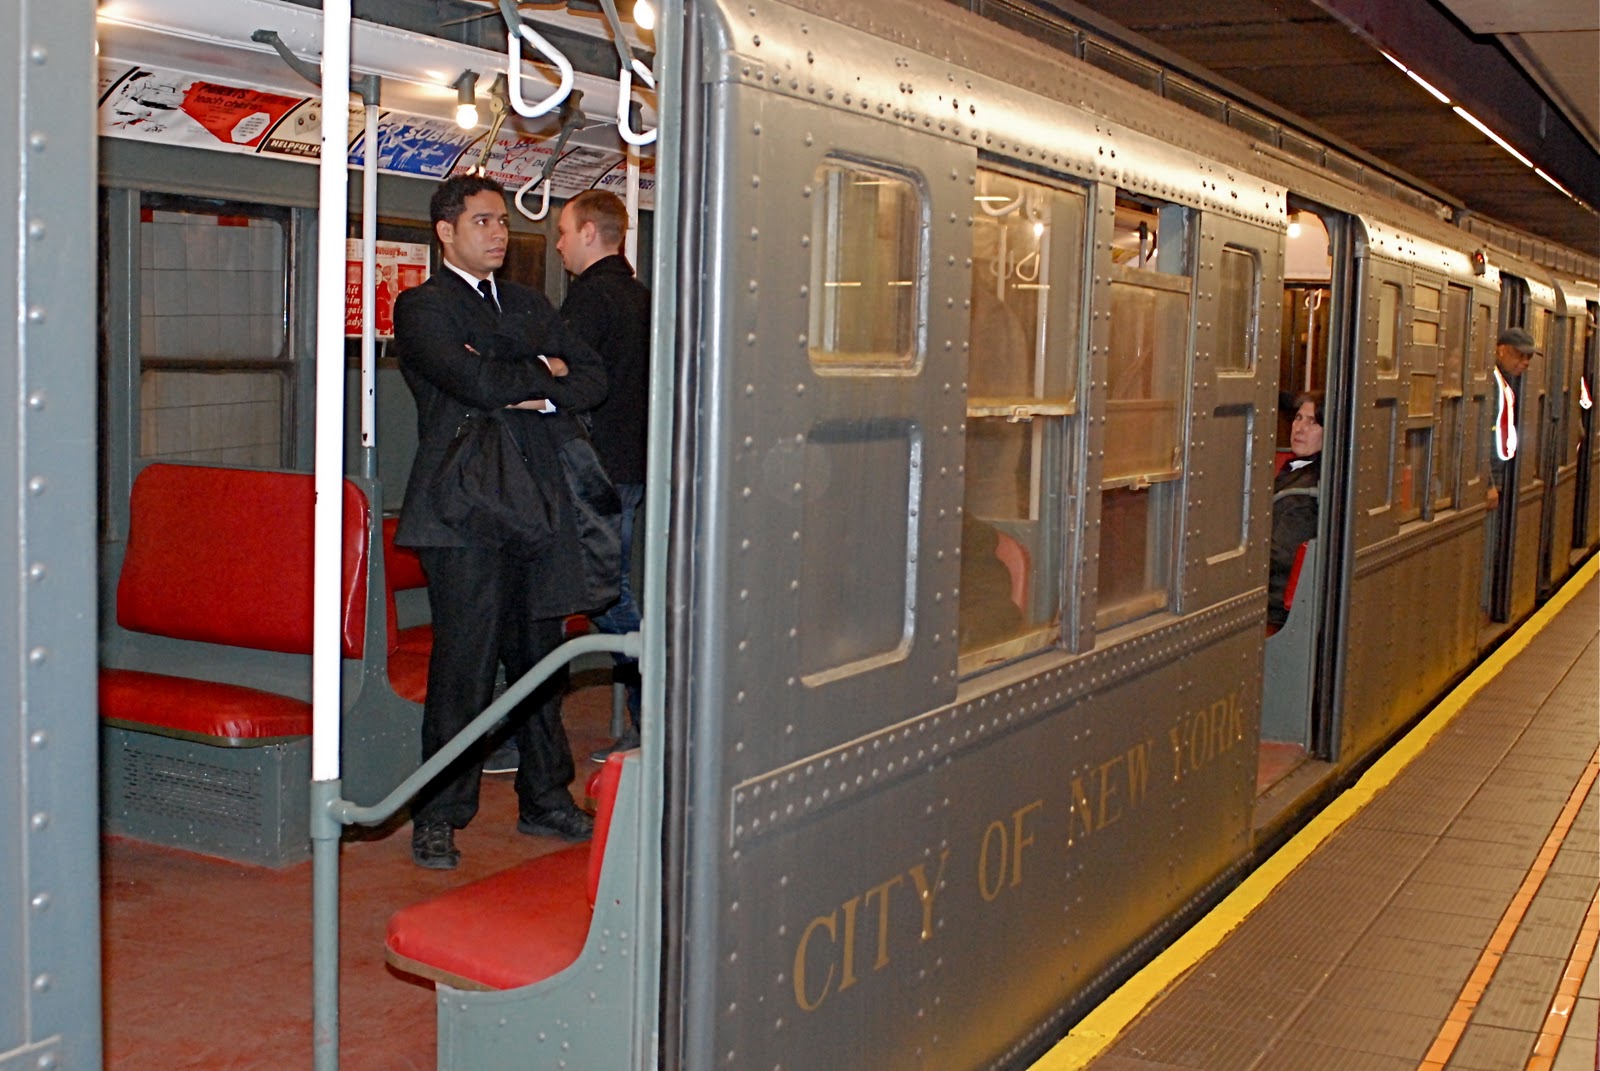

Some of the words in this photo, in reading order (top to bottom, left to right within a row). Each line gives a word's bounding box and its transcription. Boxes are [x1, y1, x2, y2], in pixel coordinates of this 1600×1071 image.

[194, 95, 223, 105] teach
[224, 99, 263, 110] children
[404, 126, 473, 147] SUBWAY
[271, 140, 310, 150] HELPFUL
[346, 284, 359, 294] hit
[793, 847, 950, 1012] CITY
[978, 799, 1044, 902] OF
[1068, 739, 1154, 847] NEW
[1169, 691, 1245, 781] YORK
